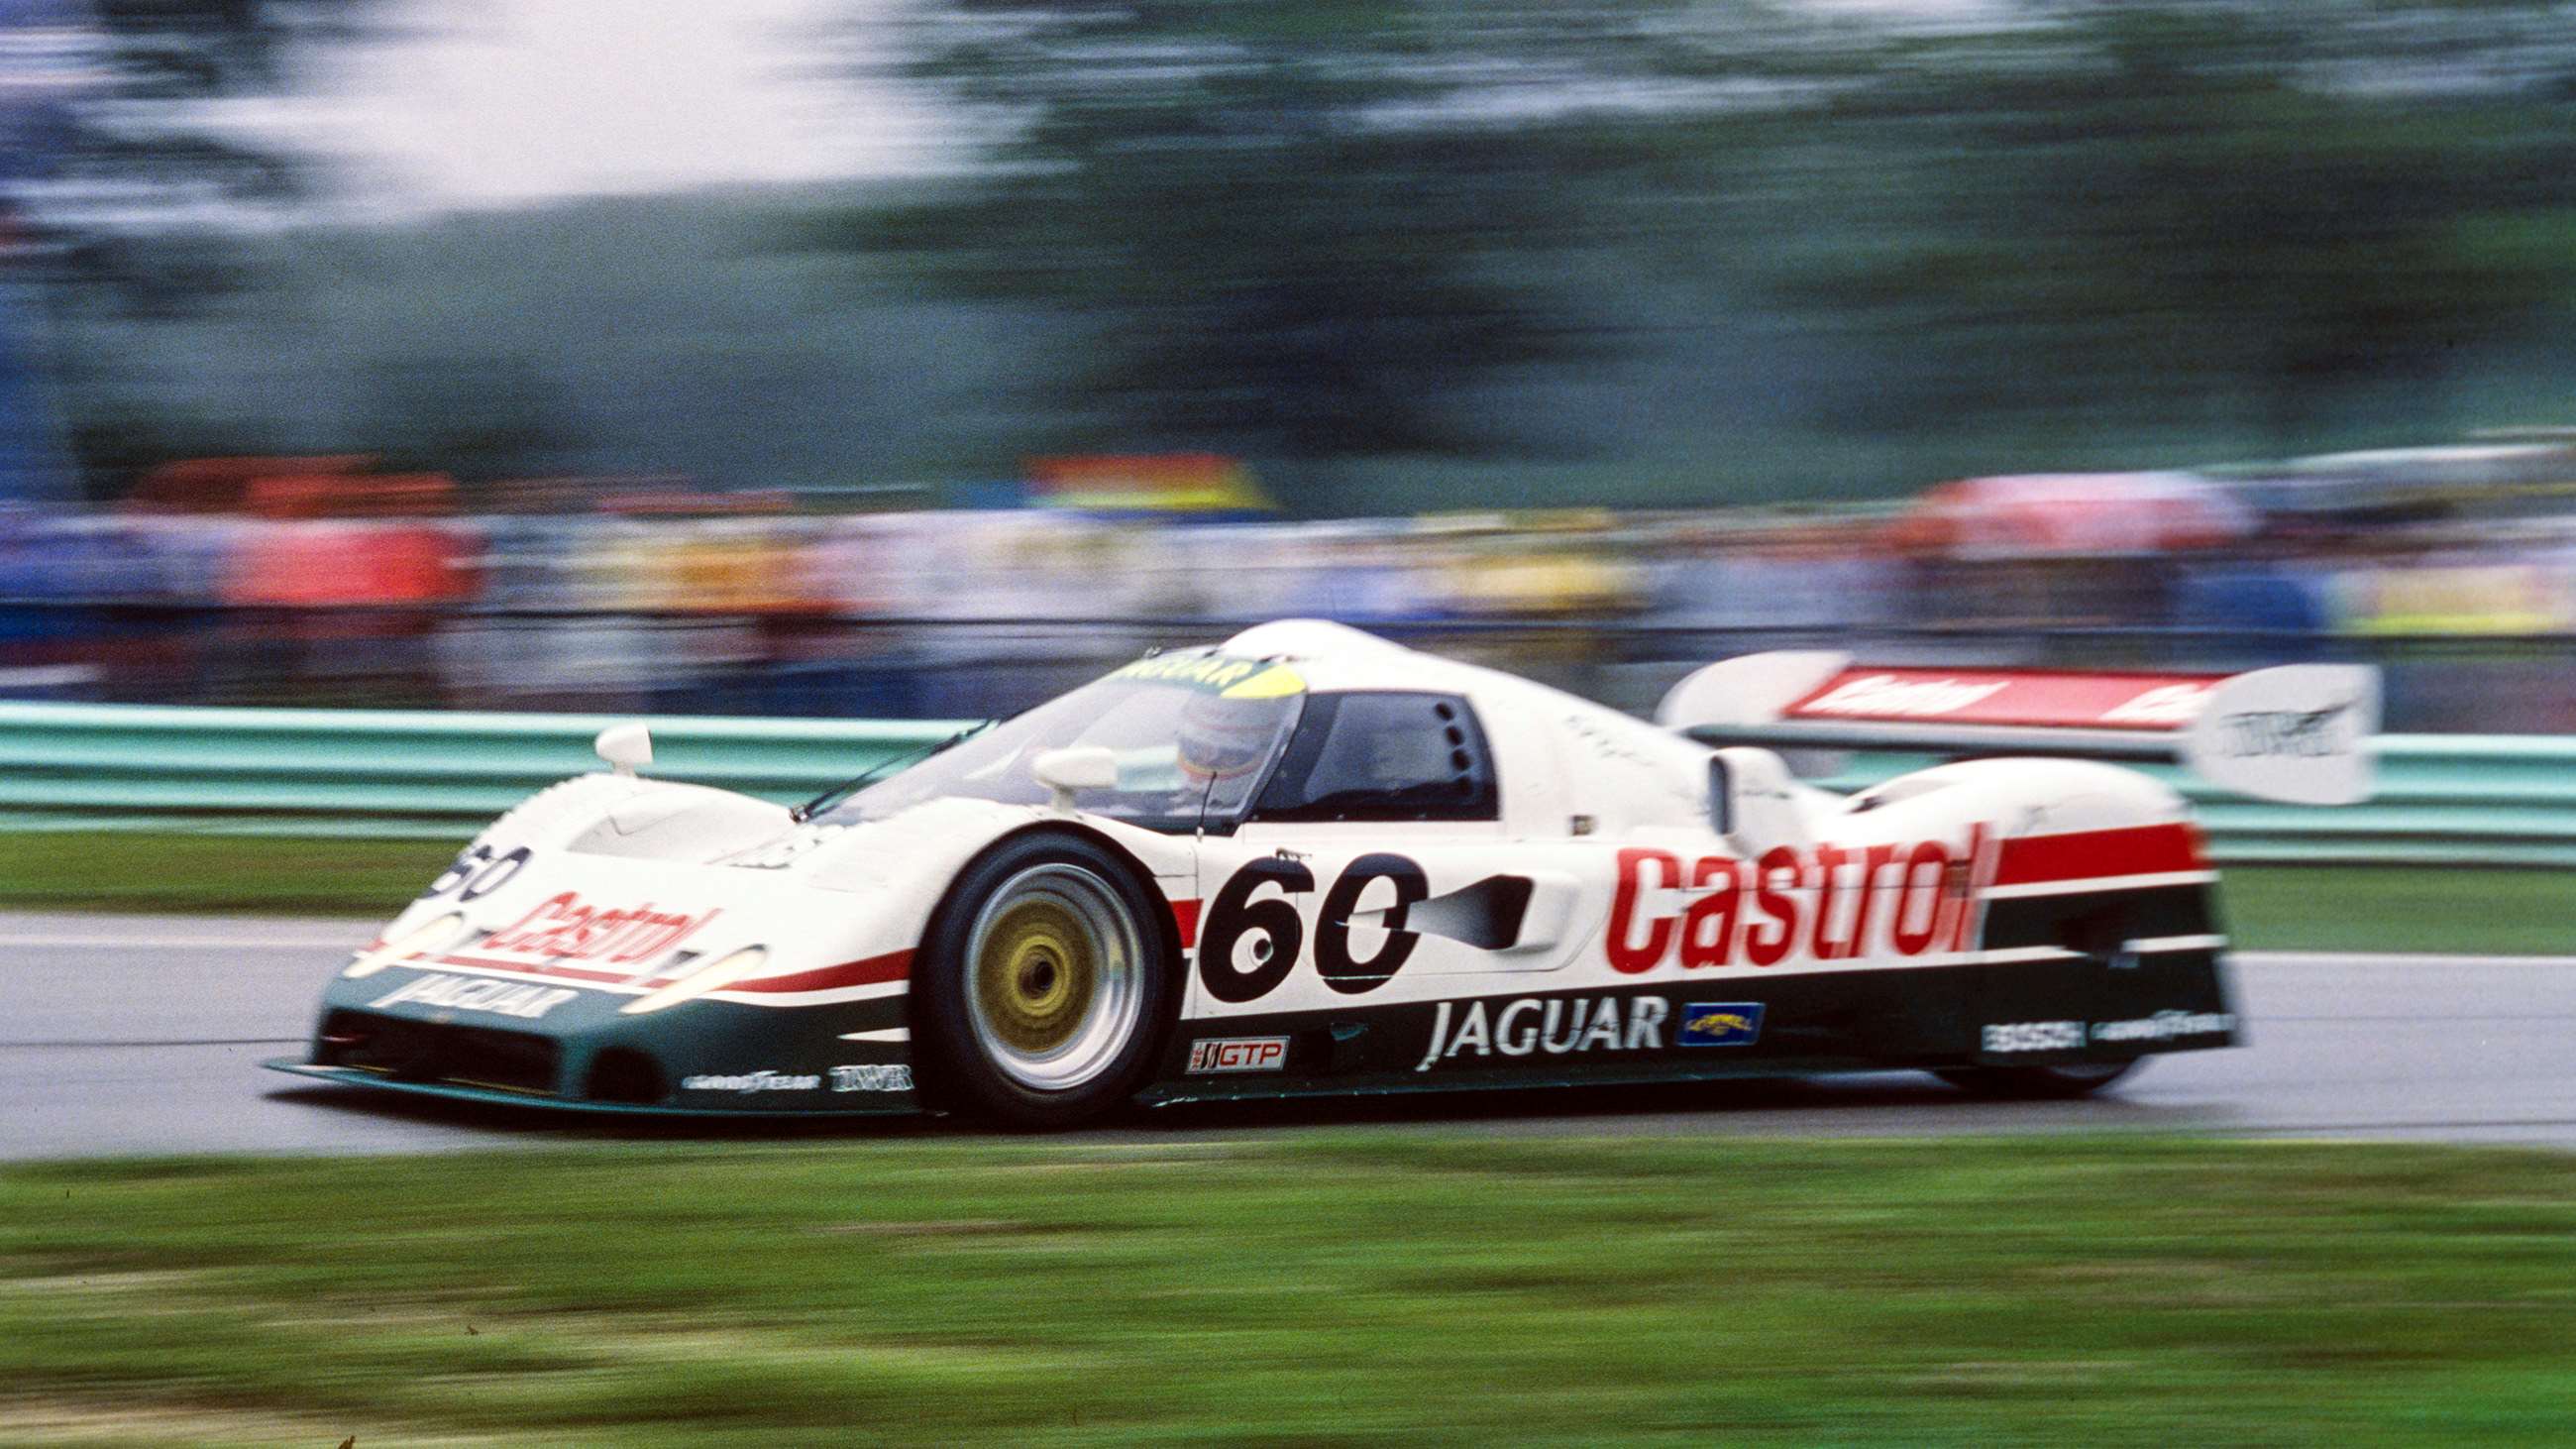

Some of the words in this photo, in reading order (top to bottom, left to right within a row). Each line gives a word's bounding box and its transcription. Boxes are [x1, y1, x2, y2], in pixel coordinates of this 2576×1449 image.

[423, 843, 534, 902] 60
[1606, 822, 1993, 974] Castrol
[482, 891, 725, 963] Castrol
[1199, 851, 1429, 1003] 60
[369, 973, 580, 1018] JAGUAR
[1220, 1043, 1283, 1065] GTP
[1415, 996, 1669, 1071] JAGUAR
